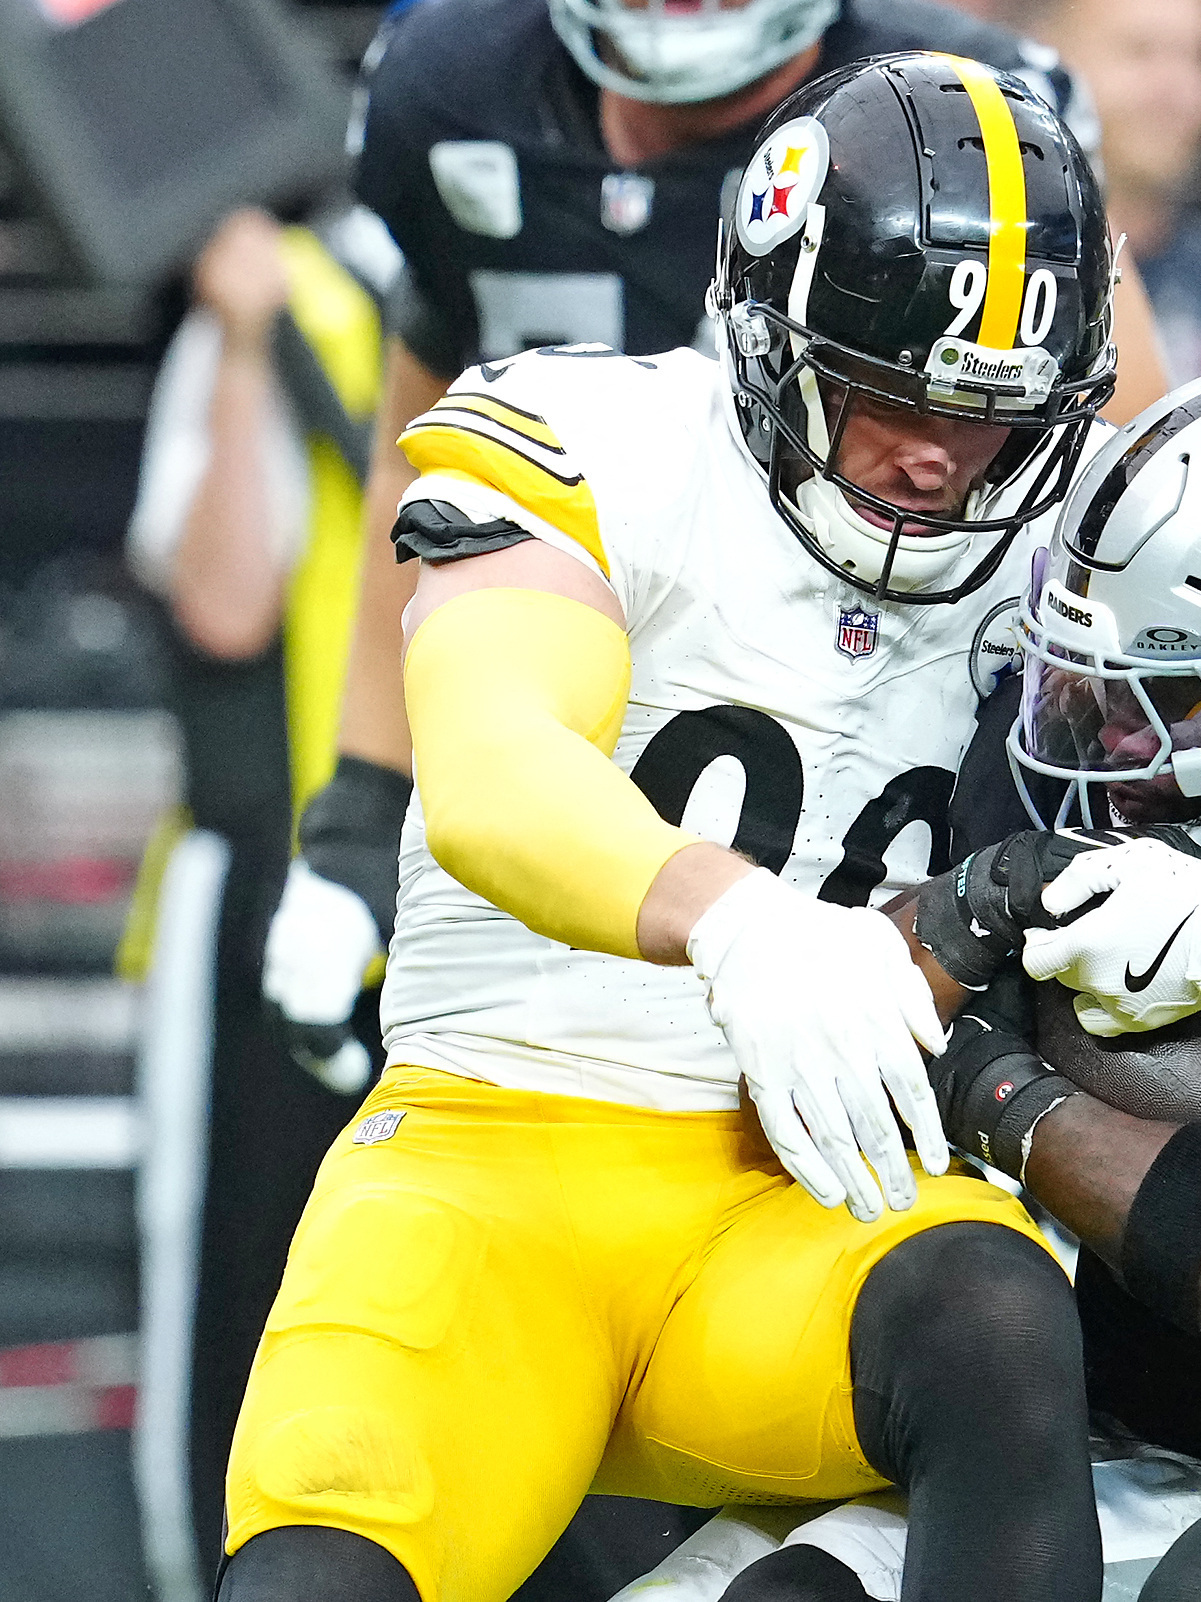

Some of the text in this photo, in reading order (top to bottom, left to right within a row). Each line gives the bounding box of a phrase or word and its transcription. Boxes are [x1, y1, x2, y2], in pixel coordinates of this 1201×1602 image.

[943, 259, 1058, 347] 90
[961, 351, 1023, 380] Steelers
[1047, 591, 1093, 628] RAIDERS
[842, 627, 872, 652] NFL
[981, 639, 1015, 657] Steelers
[1136, 641, 1200, 651] OAKLEY
[360, 1121, 389, 1137] NFL
[977, 1130, 995, 1165] sed
